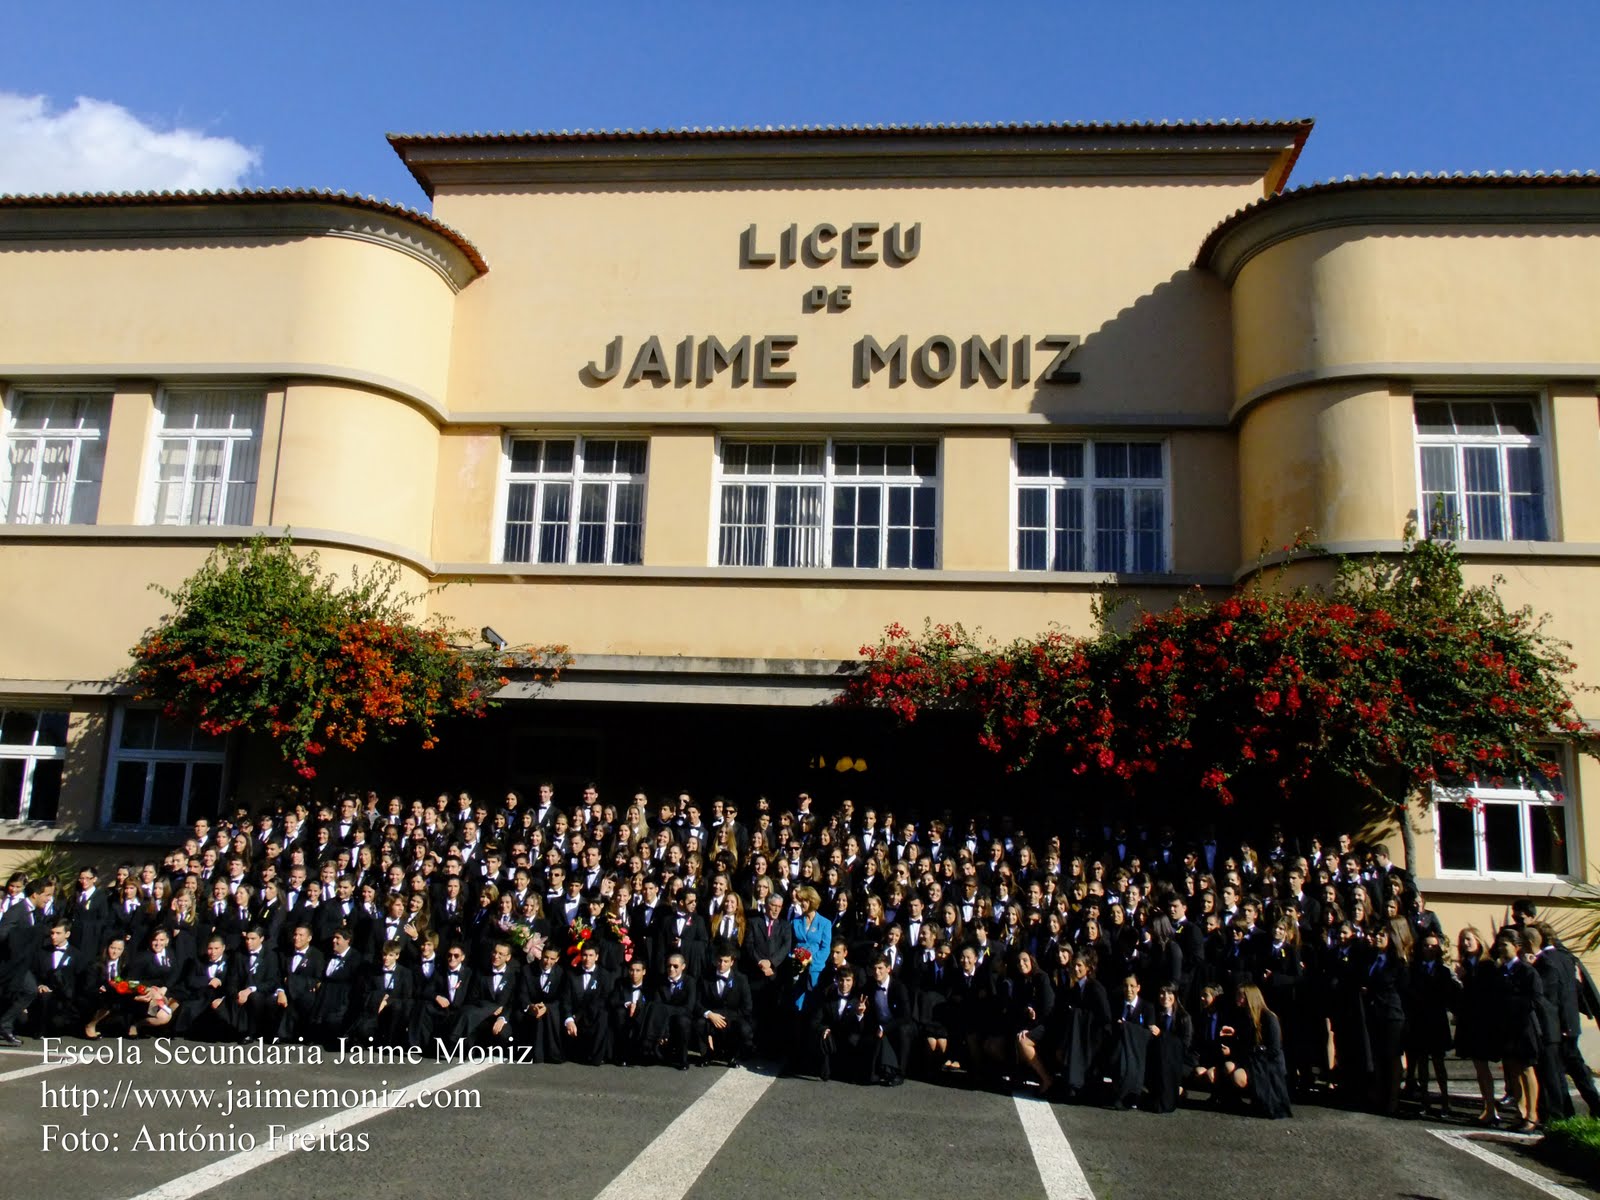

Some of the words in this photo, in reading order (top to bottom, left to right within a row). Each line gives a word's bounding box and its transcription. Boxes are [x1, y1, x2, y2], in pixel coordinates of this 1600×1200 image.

[742, 222, 922, 267] LICEU
[806, 285, 852, 312] DE
[580, 335, 798, 387] JAIME
[856, 335, 1081, 387] MONIZ
